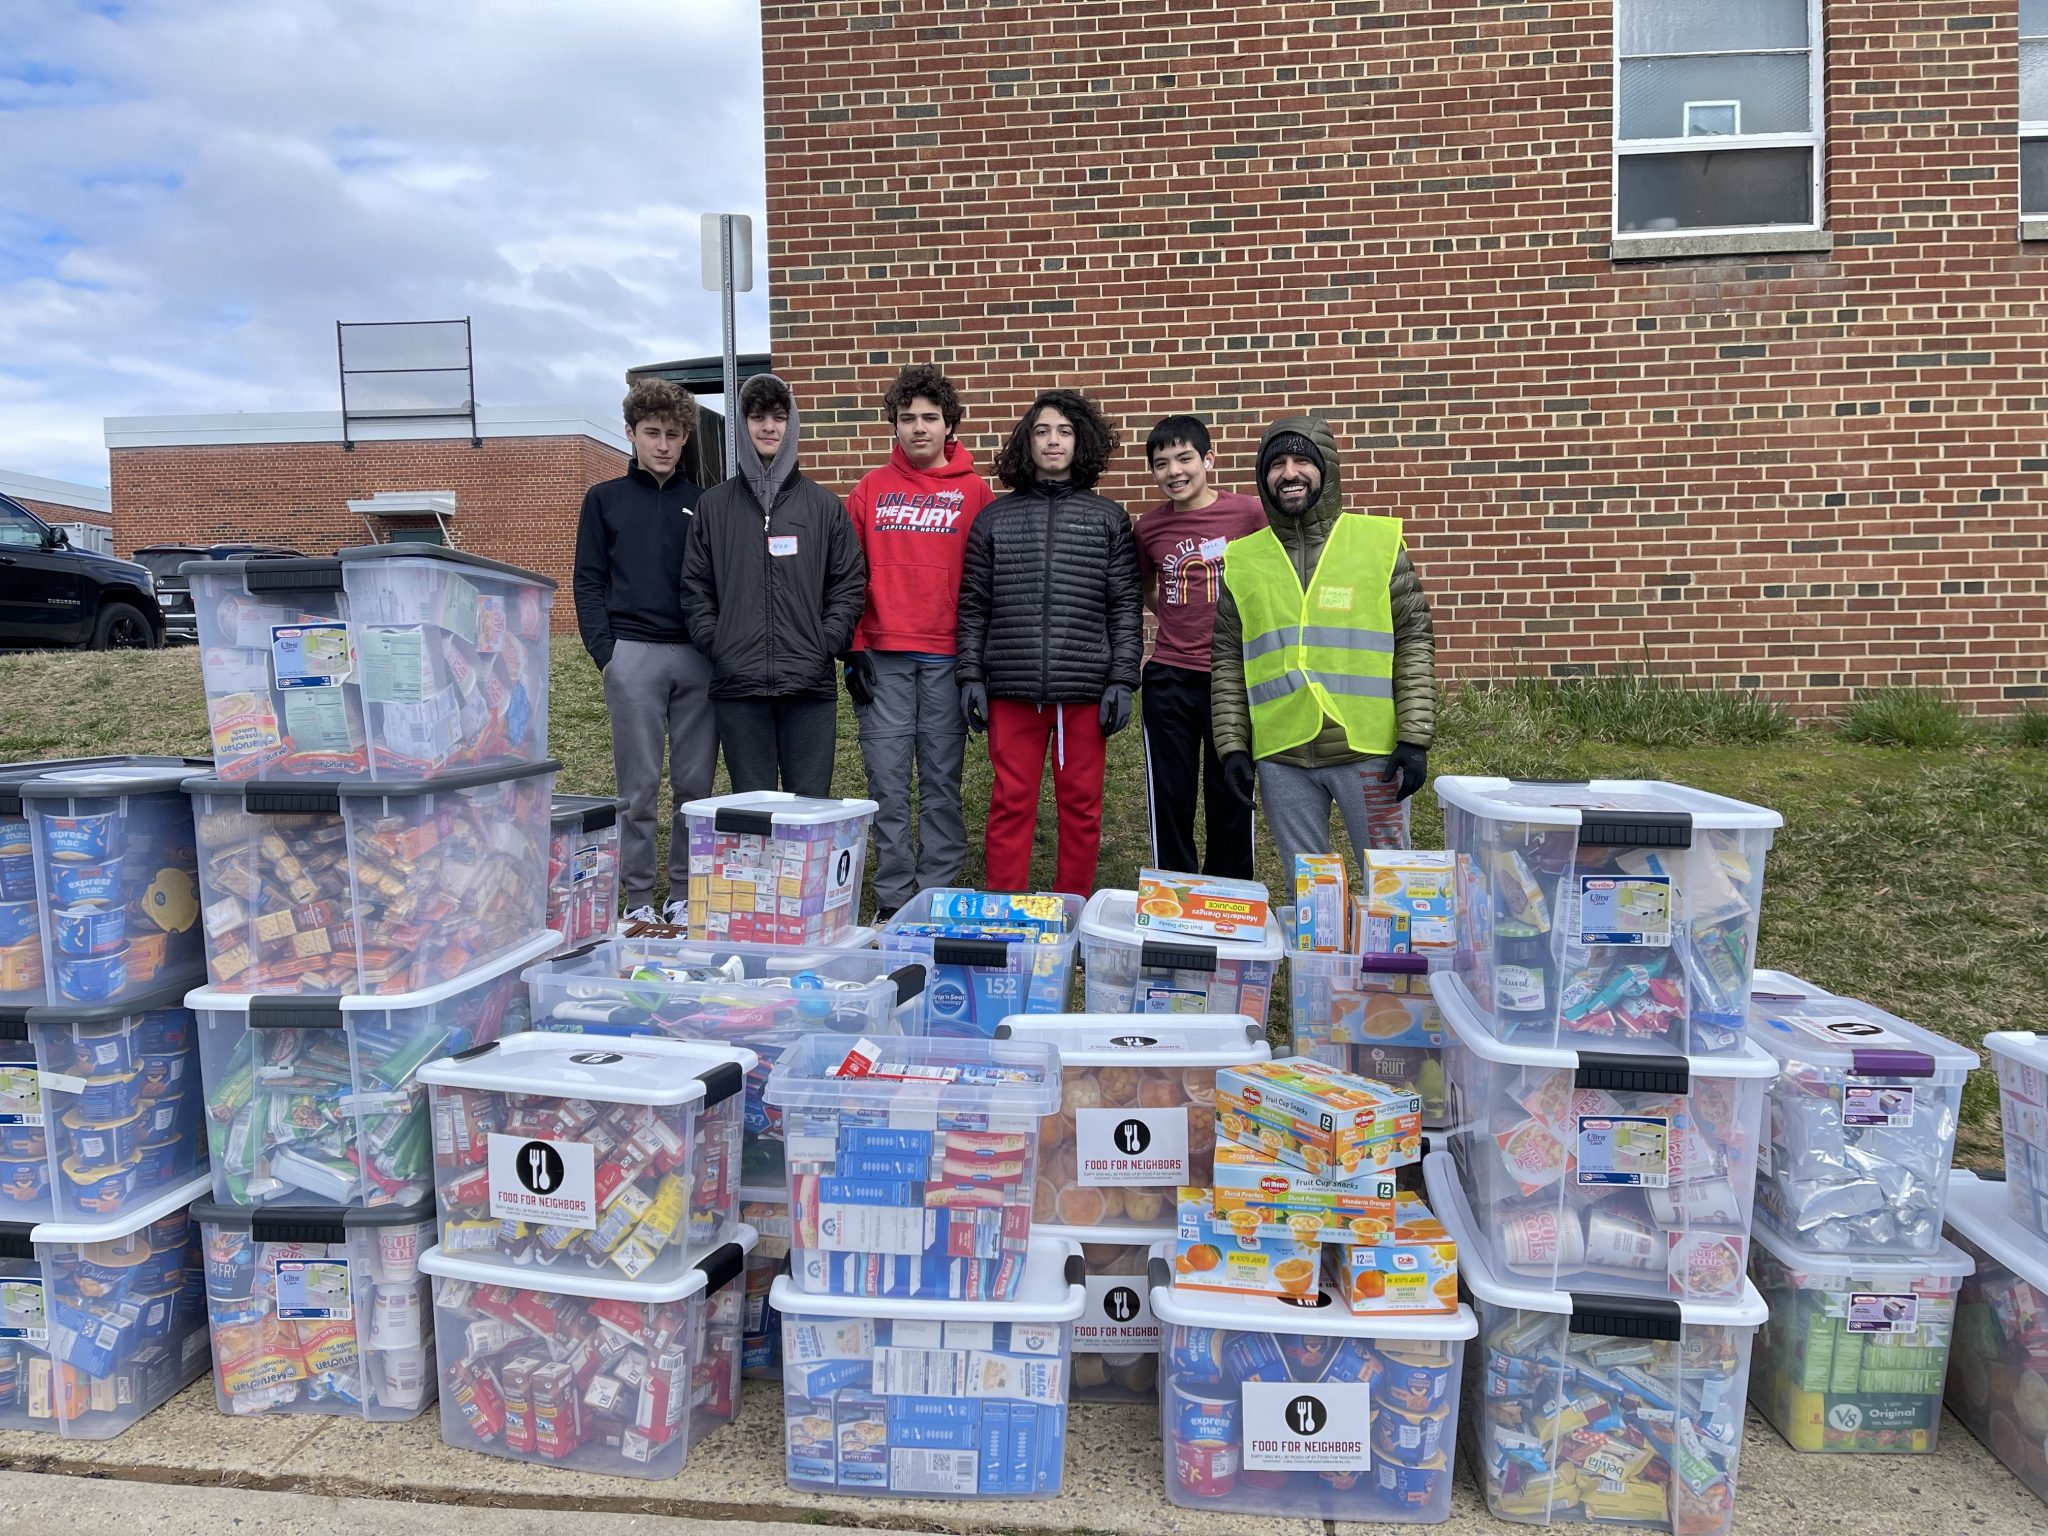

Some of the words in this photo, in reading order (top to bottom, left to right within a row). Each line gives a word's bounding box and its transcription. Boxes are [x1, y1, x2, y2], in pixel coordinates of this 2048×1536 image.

[876, 492, 963, 511] UNLEASH
[876, 506, 900, 518] THE
[896, 506, 961, 527] FURY
[1163, 554, 1178, 604] BEHIND
[1176, 538, 1195, 554] TO
[232, 727, 257, 735] Lunch
[50, 831, 90, 841] express
[57, 839, 79, 847] mac
[68, 878, 111, 889] express
[78, 886, 103, 894] mac
[1591, 894, 1609, 902] Ultra
[1208, 902, 1228, 910] JUICE
[1192, 908, 1220, 918] Oranges
[1222, 912, 1258, 922] Mandarin
[1177, 922, 1189, 930] Cup
[986, 978, 1017, 994] 152
[1376, 1061, 1405, 1074] FRUIT
[1266, 1095, 1278, 1104] Fruit
[1278, 1099, 1289, 1108] Cup
[1290, 1102, 1308, 1116] Snacks
[1322, 1115, 1331, 1126] 12
[1587, 1133, 1607, 1142] Ultra
[1085, 1160, 1108, 1170] FOOD
[1111, 1160, 1128, 1170] FOR
[1131, 1160, 1181, 1169] NEIGHBORS
[1315, 1179, 1331, 1188] Cup
[1333, 1181, 1358, 1190] Snacks
[1380, 1184, 1391, 1194] 12
[498, 1191, 518, 1204] FOOD
[520, 1193, 537, 1206] FOR
[538, 1196, 586, 1212] NEIGHBORS
[1342, 1198, 1369, 1206] Mandarin
[1181, 1229, 1189, 1238] 12
[383, 1235, 416, 1249] CUP
[1356, 1255, 1365, 1264] 12
[82, 1263, 126, 1281] Deluxe
[970, 1259, 979, 1281] Salad
[1001, 1259, 1014, 1280] Salad
[283, 1275, 300, 1283] Ultra
[867, 1271, 875, 1292] Salad
[969, 1281, 978, 1298] Tuna
[996, 1280, 1007, 1296] Tuna
[320, 1326, 349, 1338] Chicken
[1074, 1327, 1097, 1337] FOOD
[1101, 1327, 1117, 1337] FOR
[1120, 1327, 1159, 1337] NEIGHBO
[319, 1344, 336, 1354] Soup
[330, 1347, 352, 1356] Ramen
[232, 1370, 287, 1393] Maruchan
[1036, 1363, 1047, 1398] SNACK
[1835, 1408, 1856, 1427] V8
[1869, 1407, 1915, 1419] Original
[1190, 1417, 1231, 1428] express
[1200, 1426, 1222, 1436] mac
[1252, 1440, 1278, 1452] FOOD
[1281, 1441, 1301, 1452] FOR
[1304, 1441, 1362, 1453] NEIGHBORS
[1588, 1455, 1625, 1477] belVita
